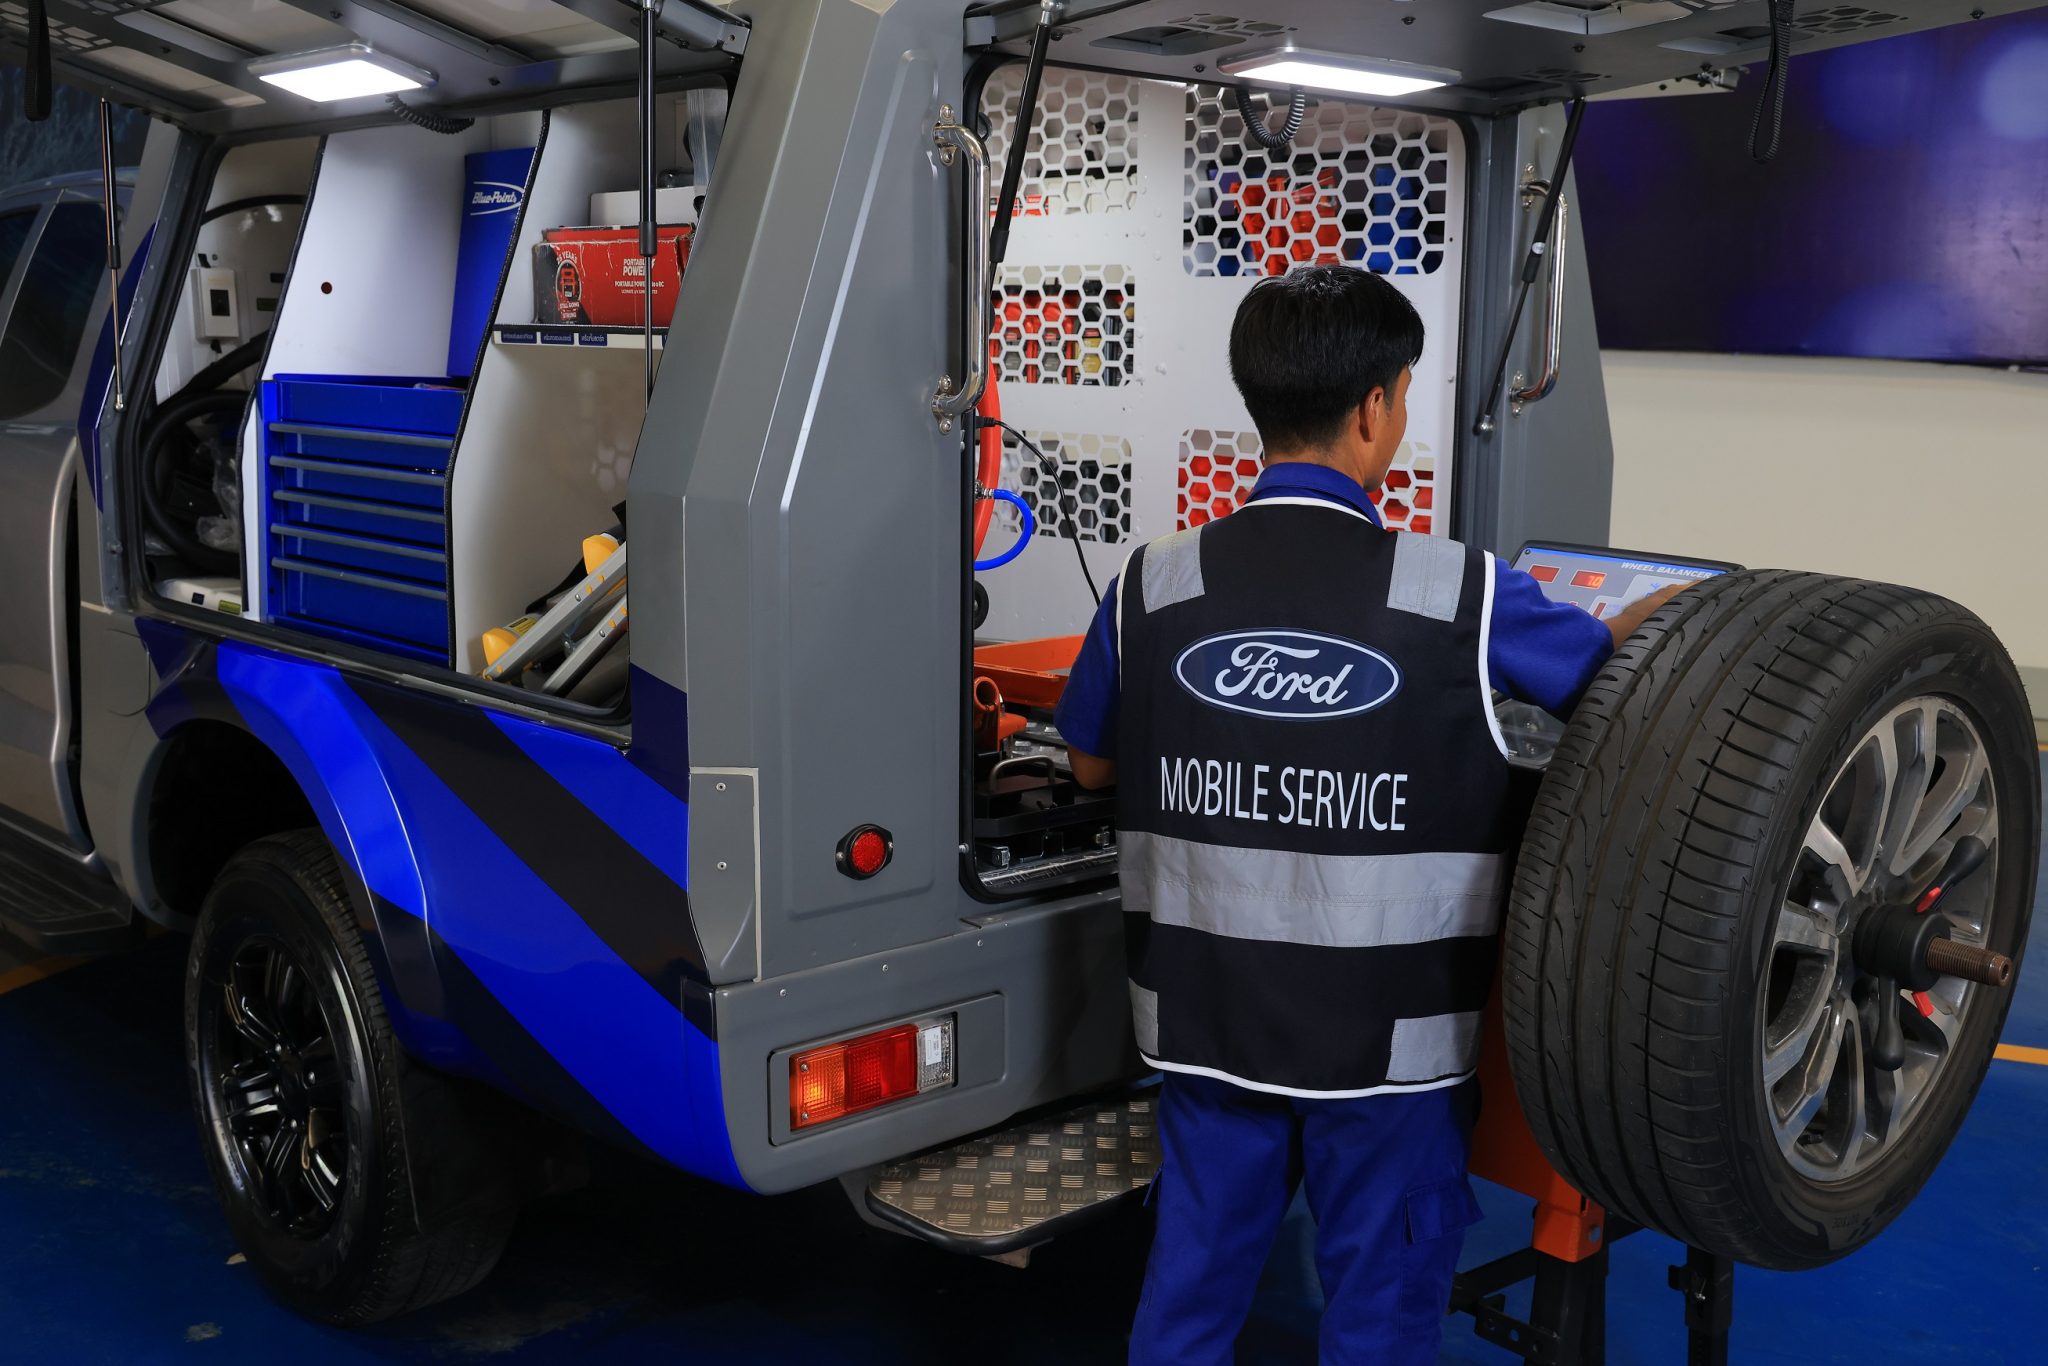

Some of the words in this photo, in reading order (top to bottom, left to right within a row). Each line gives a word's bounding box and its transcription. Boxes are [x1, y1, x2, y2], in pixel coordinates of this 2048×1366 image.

[1621, 561, 1655, 573] WHEEL
[1656, 566, 1713, 579] BALANCER
[1214, 641, 1354, 705] Ford
[1160, 756, 1270, 822] MOBILE
[1278, 766, 1408, 831] SERVICE
